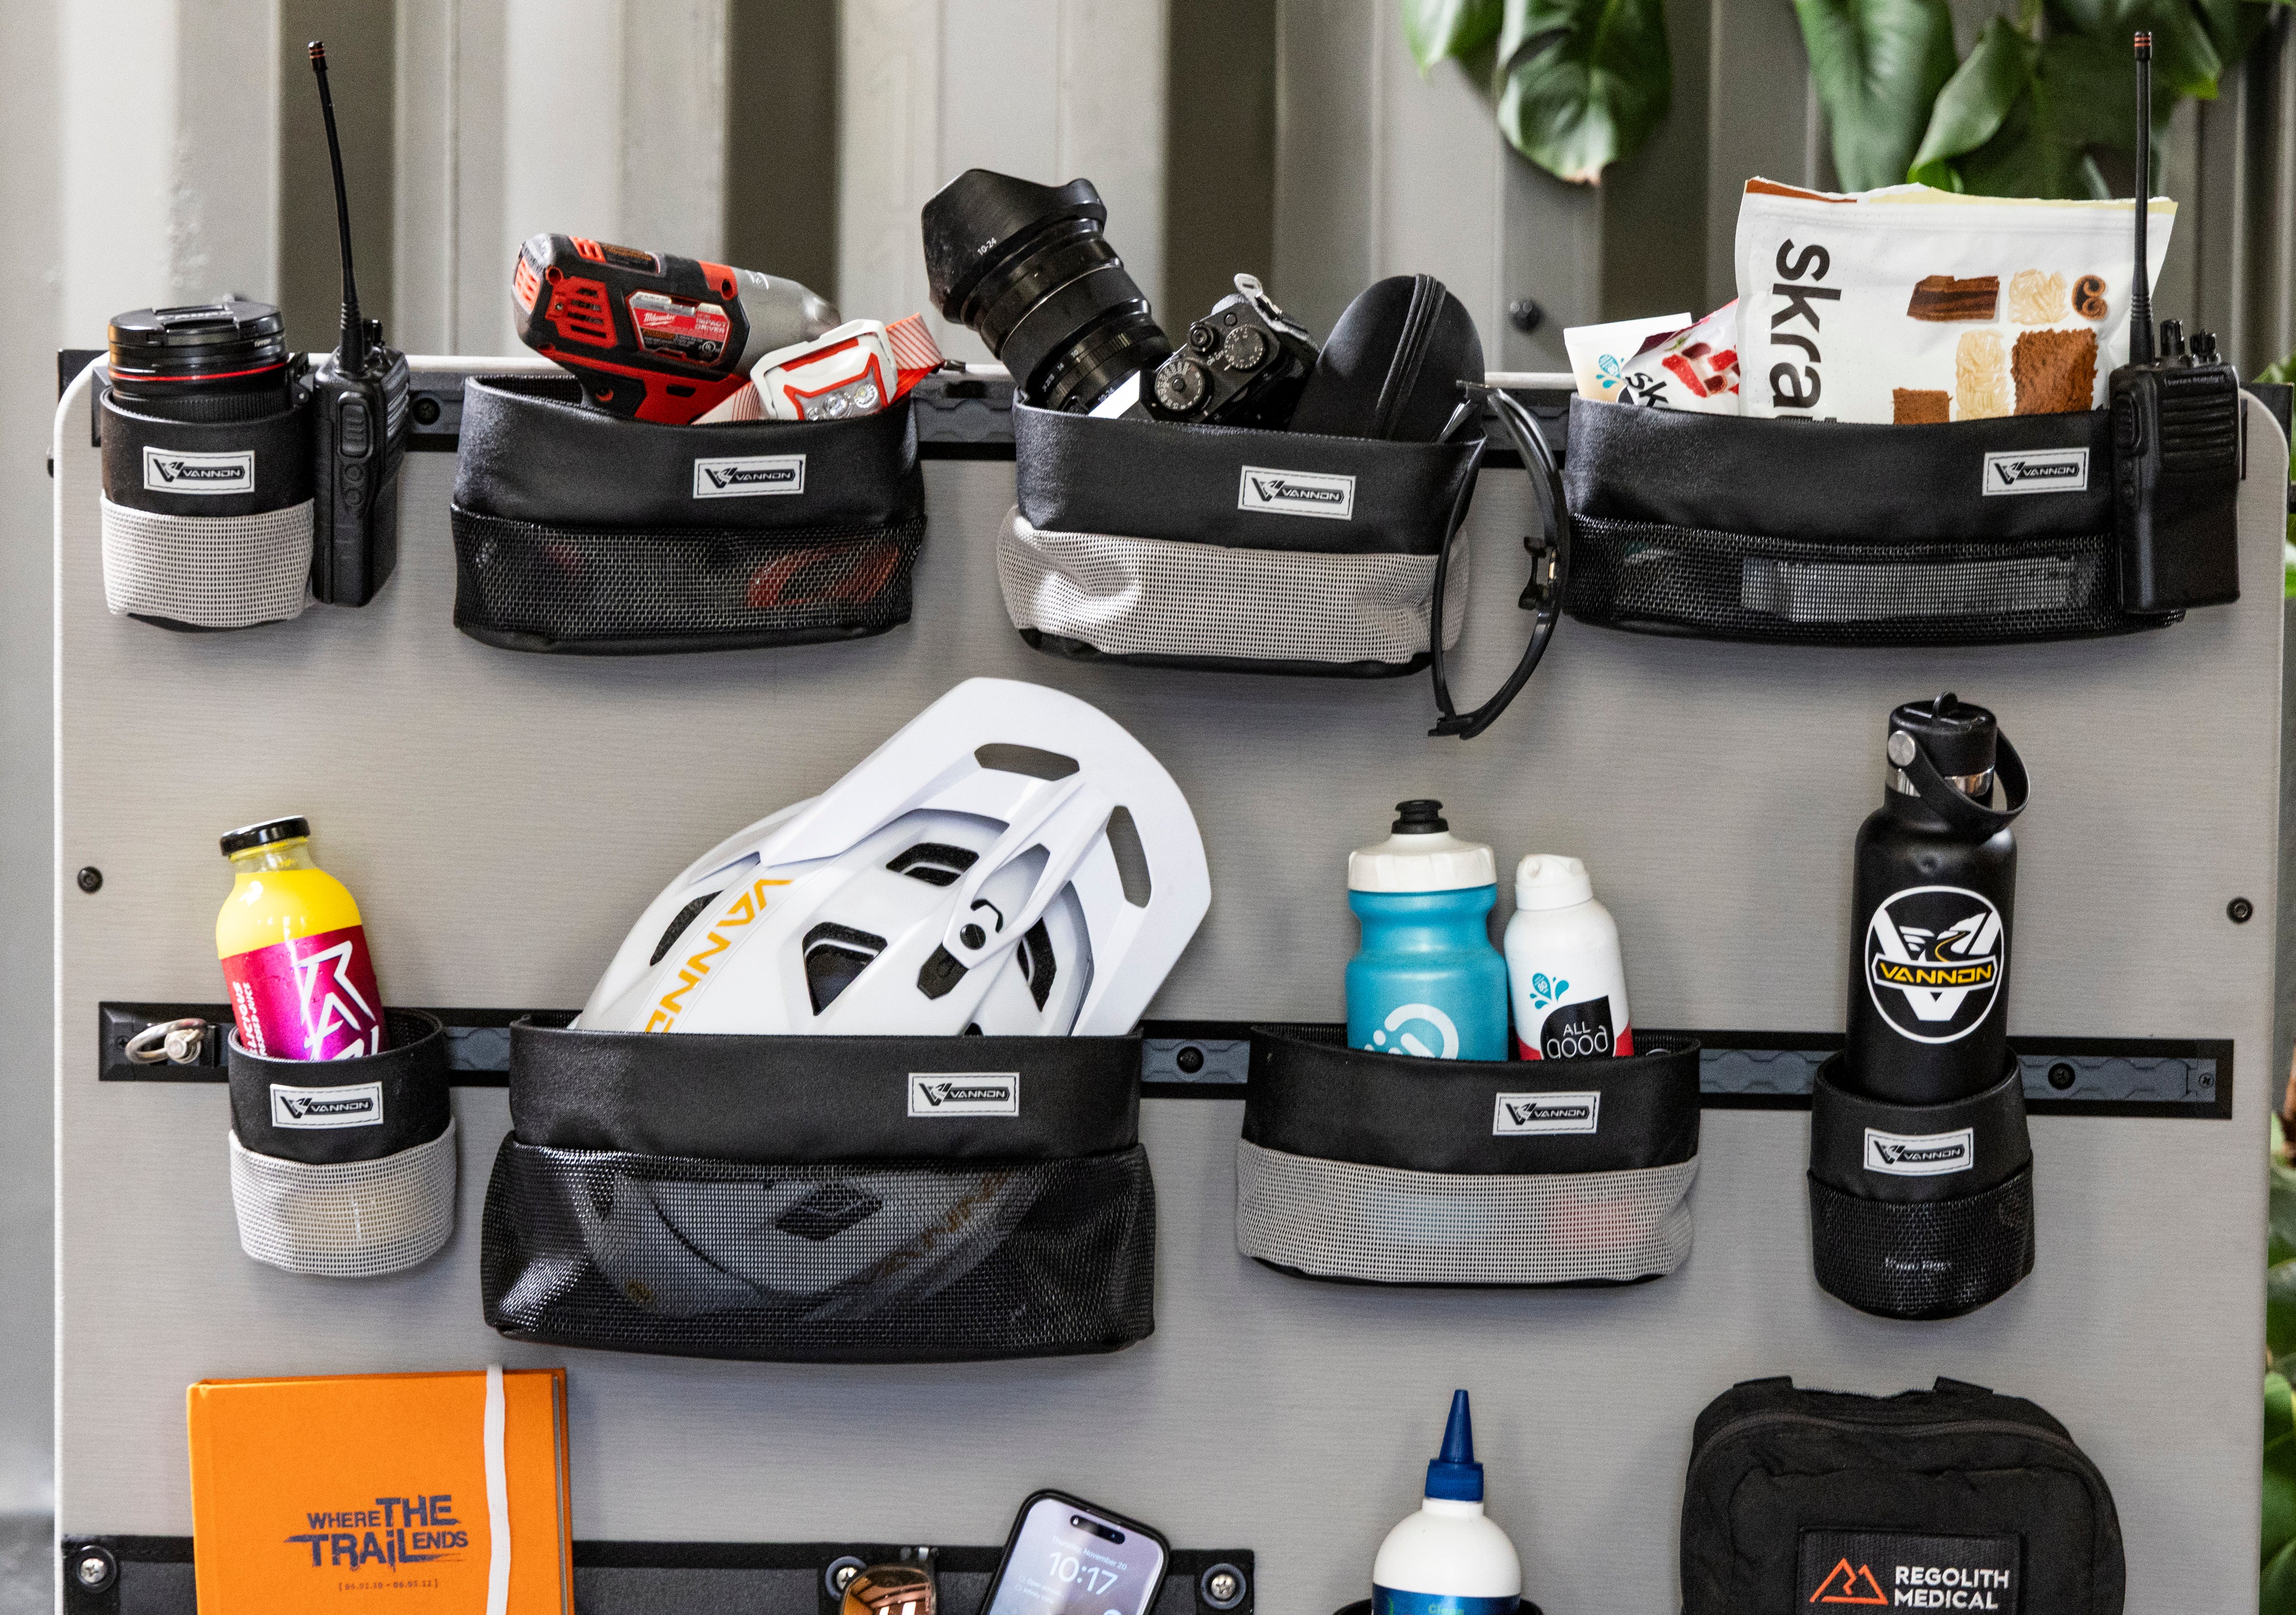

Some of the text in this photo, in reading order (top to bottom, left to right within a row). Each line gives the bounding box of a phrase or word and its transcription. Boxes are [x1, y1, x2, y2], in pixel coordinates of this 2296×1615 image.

[977, 237, 996, 256] 10-24
[1769, 238, 1841, 421] skra
[183, 469, 240, 478] VANNON
[735, 472, 791, 481] VANNON
[2023, 466, 2076, 476] VANNON
[1282, 488, 1340, 501] VANNON
[1880, 962, 1992, 984] VANNON
[243, 982, 257, 1014] JUICE
[1563, 1021, 1591, 1036] ALL
[950, 1090, 1005, 1098] VANNON
[310, 1101, 368, 1112] VANNON
[1534, 1109, 1585, 1117] VANNON
[1903, 1149, 1960, 1160] VANNON
[307, 1495, 461, 1529] WHERE THE
[412, 1531, 469, 1549] ENDS
[1083, 1548, 1116, 1567] November
[1118, 1561, 1127, 1571] 20
[1049, 1551, 1118, 1595] 10:17
[1895, 1565, 2010, 1589] REGOLITH
[1894, 1588, 1999, 1609] MEDICAL
